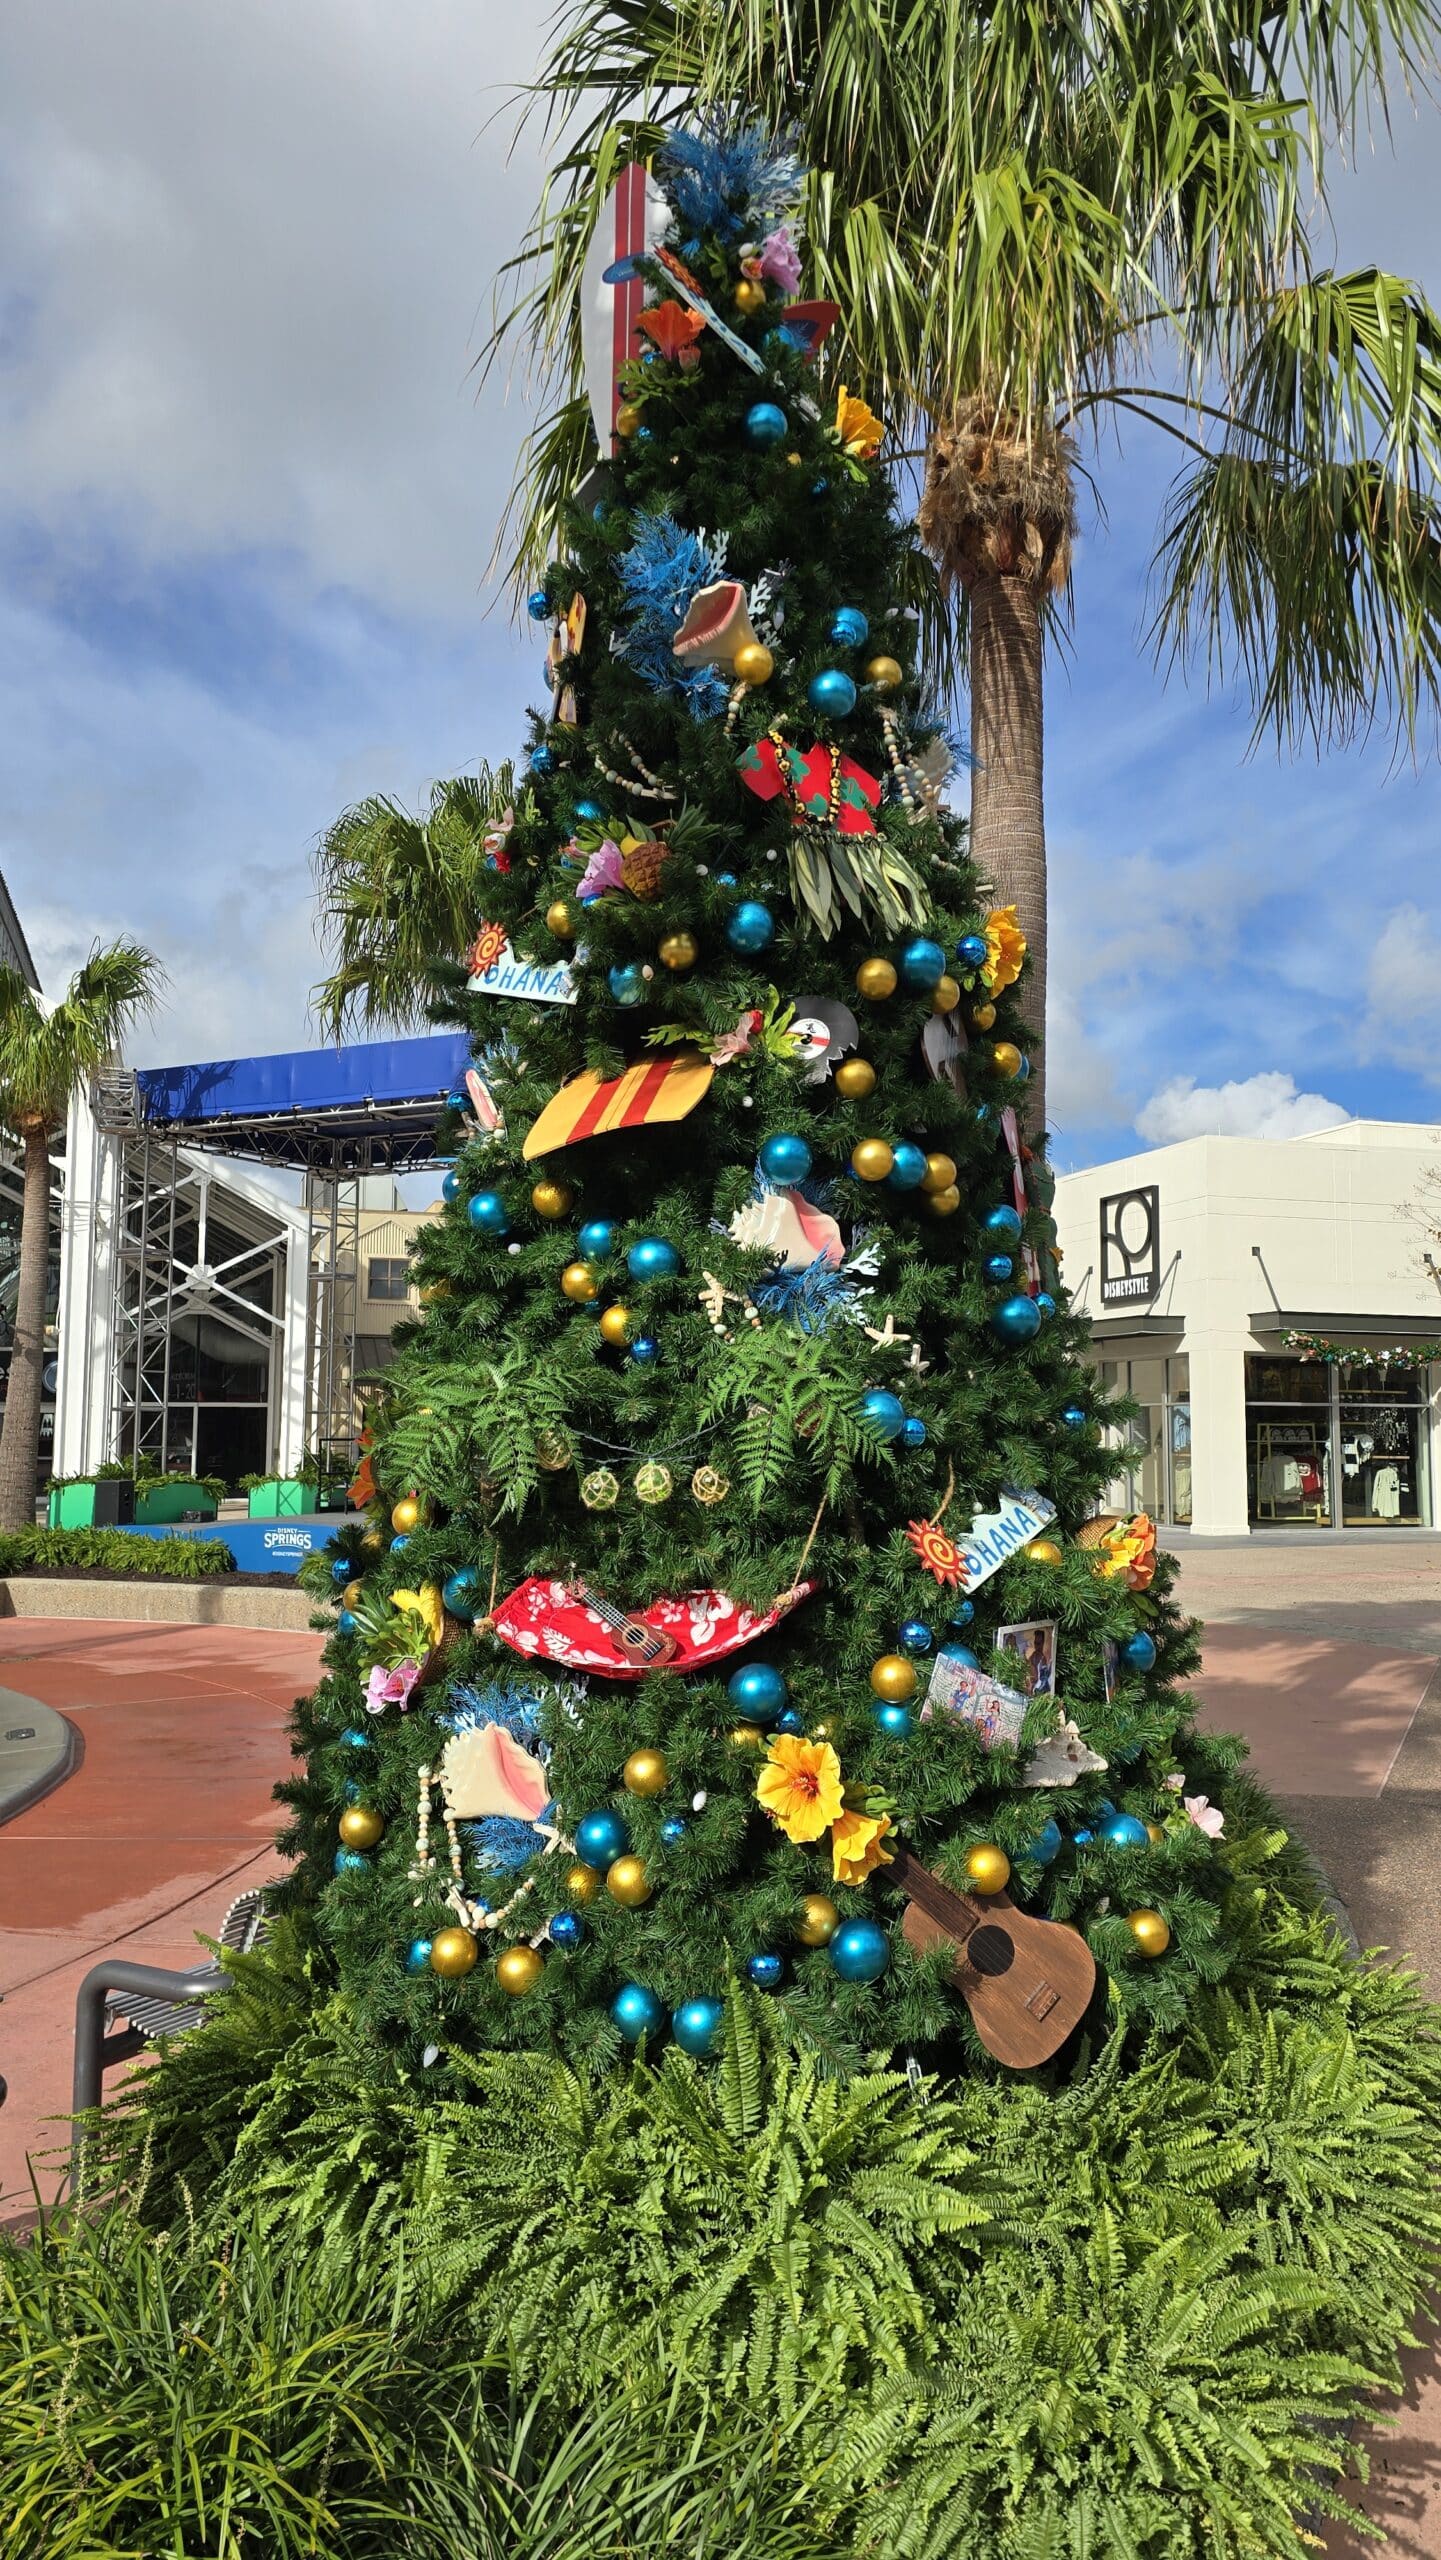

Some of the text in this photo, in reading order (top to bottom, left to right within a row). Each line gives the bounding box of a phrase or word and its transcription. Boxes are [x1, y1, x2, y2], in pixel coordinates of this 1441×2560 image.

[484, 966, 563, 996] OHANA
[1104, 1276, 1149, 1298] DISNEYSTYLE
[264, 1533, 312, 1549] SPRINGS
[963, 1506, 1037, 1575] OHANA
